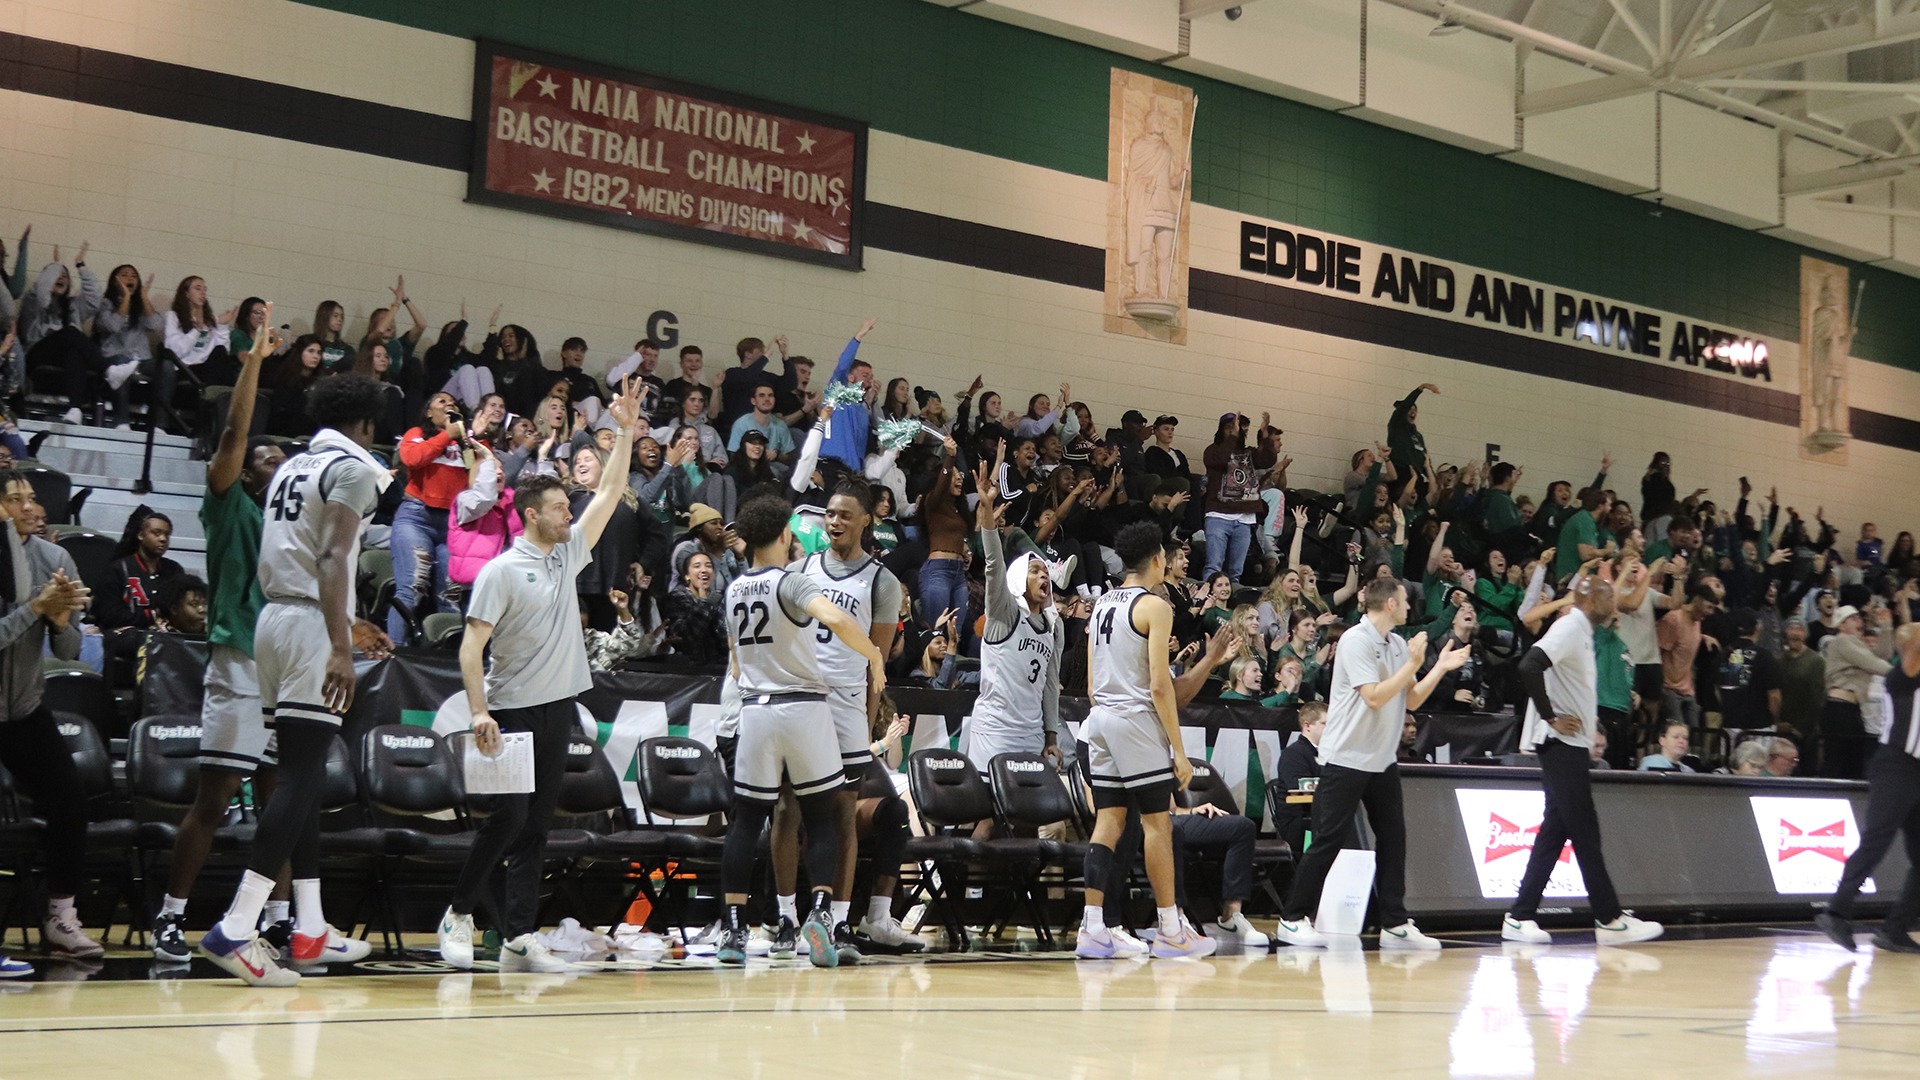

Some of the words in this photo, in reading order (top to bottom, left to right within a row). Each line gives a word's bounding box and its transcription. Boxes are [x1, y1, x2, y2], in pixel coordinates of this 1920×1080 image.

[571, 77, 640, 124] NAIA
[655, 95, 785, 154] NATIONAL
[496, 107, 670, 175] BASKETBALL
[687, 150, 846, 208] CHAMPIONS
[699, 197, 784, 237] DIVISION
[1240, 220, 1361, 294] EDDIE
[1371, 252, 1456, 313] AND
[1465, 273, 1544, 333] ANN
[1554, 292, 1661, 358] PAYNE
[1669, 321, 1772, 383] ARENA
[647, 311, 682, 350] G
[269, 474, 310, 521] 45
[732, 579, 771, 598] SPARTANS
[820, 588, 861, 617] STATE
[733, 601, 774, 647] 22
[1095, 606, 1117, 646] 14
[1027, 658, 1041, 684] 3
[382, 734, 435, 749] Upstate
[568, 742, 593, 755] tate
[655, 746, 701, 760] Upstate
[925, 758, 965, 770] Upstate
[1006, 760, 1045, 772] Upstate
